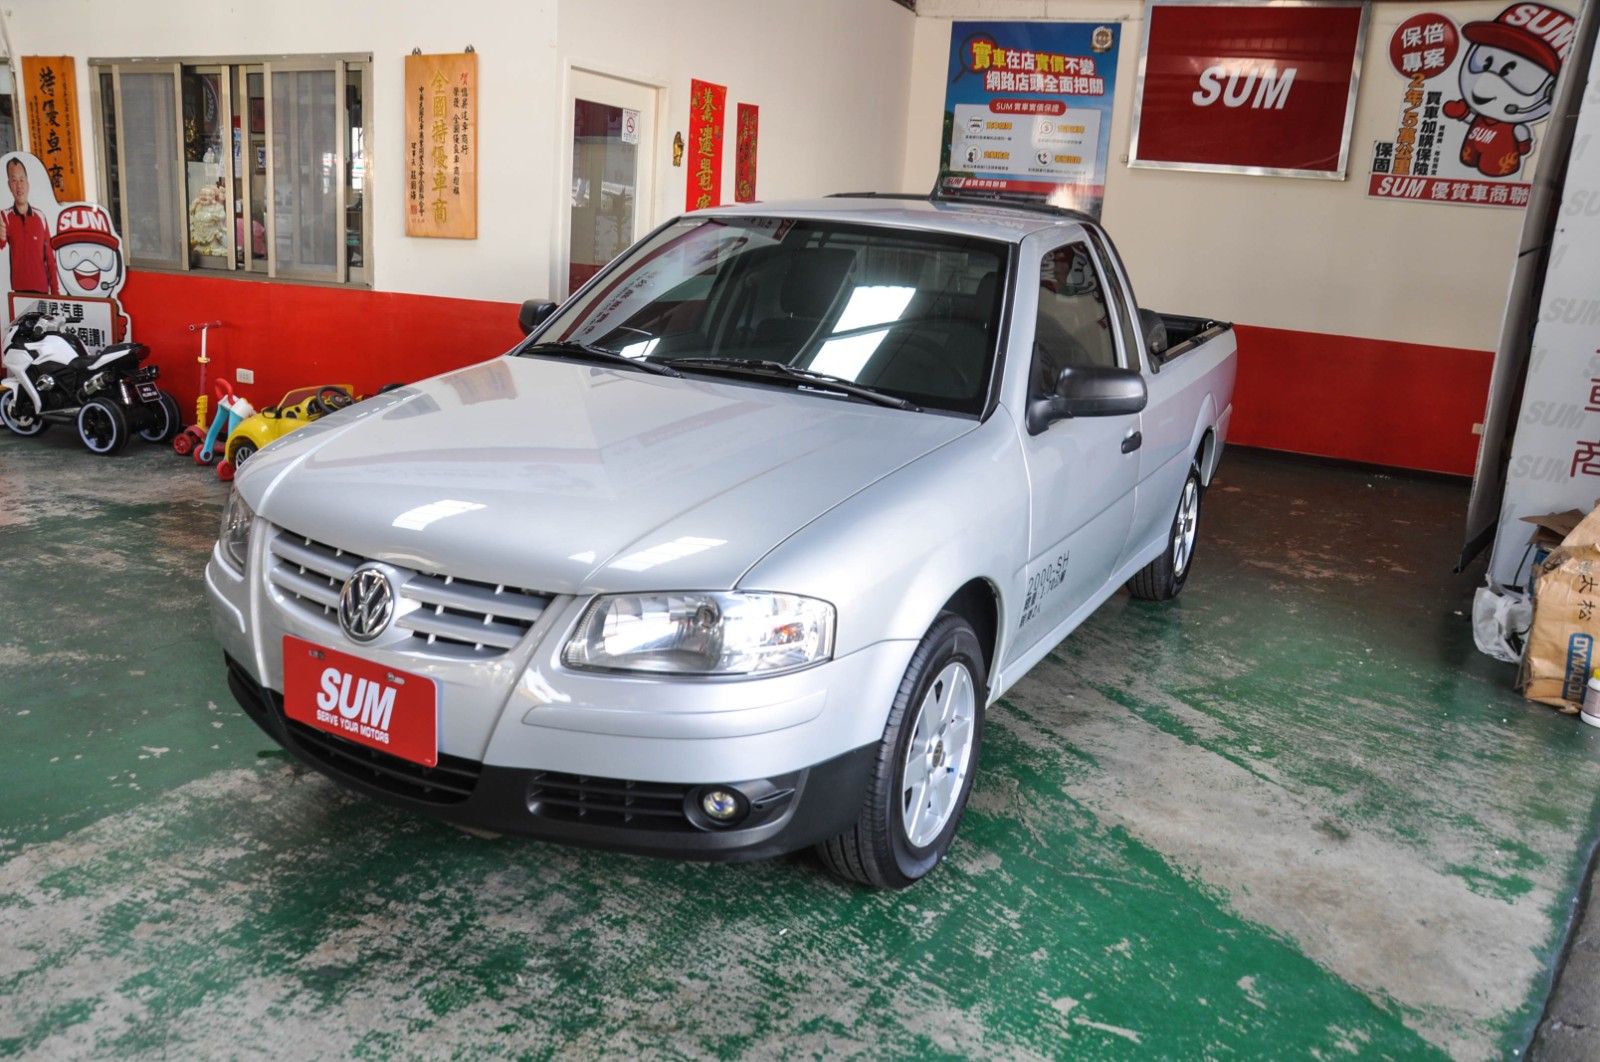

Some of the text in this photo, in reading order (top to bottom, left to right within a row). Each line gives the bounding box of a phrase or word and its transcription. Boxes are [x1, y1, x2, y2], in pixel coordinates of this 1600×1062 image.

[1401, 23, 1444, 47] 保倍
[986, 71, 1104, 94] 網路店頭全面把關
[1191, 65, 1298, 109] SUM
[996, 102, 1013, 110] SUM
[431, 70, 449, 224] 全國特優車商
[1469, 127, 1497, 145] SUM
[1373, 143, 1394, 173] 保固
[1377, 177, 1427, 198] SUM
[59, 210, 108, 232] SUM
[316, 667, 398, 731] SUM
[316, 709, 390, 744] SERVE YOUR MOTORS
